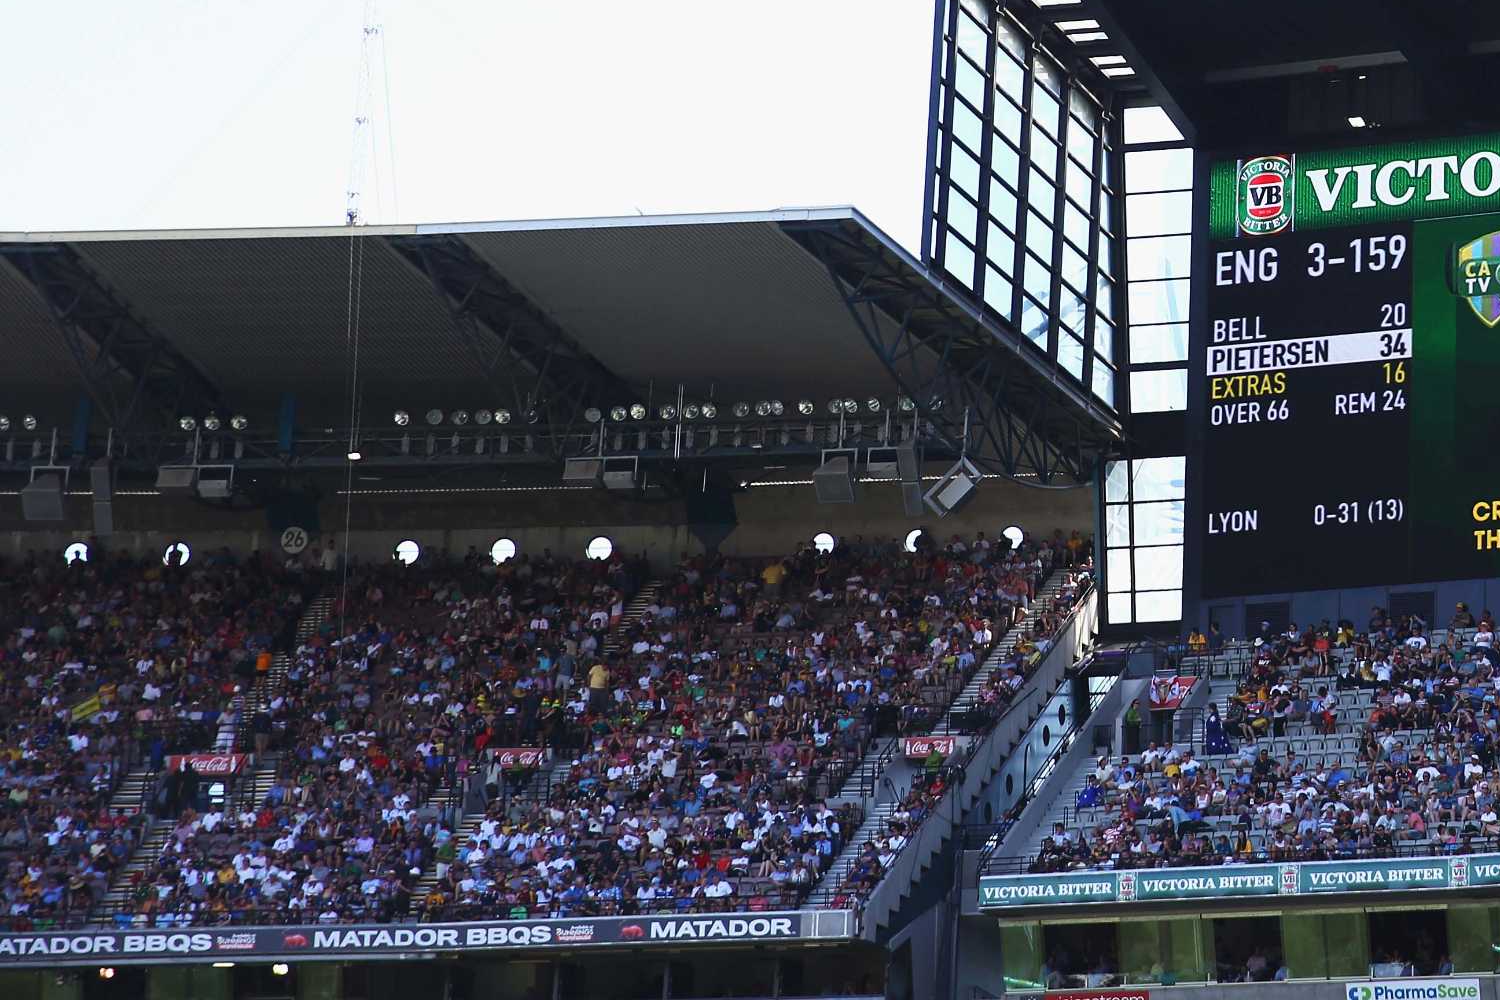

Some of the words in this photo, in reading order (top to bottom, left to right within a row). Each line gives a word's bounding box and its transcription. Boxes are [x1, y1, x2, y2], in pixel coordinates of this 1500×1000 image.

[1240, 161, 1290, 181] VICTORIA
[1249, 185, 1282, 206] VB
[1243, 214, 1288, 230] BITTER
[1215, 248, 1278, 286] ENG
[1307, 234, 1407, 277] 3-159
[1465, 262, 1490, 277] CA
[1465, 278, 1490, 294] TV
[1213, 317, 1267, 342] BELL
[1381, 303, 1406, 328] 20
[1212, 340, 1329, 372] PIETERSEN
[1379, 333, 1407, 358] 34
[1211, 372, 1286, 399] EXTRAS
[1383, 363, 1405, 384] 16
[1211, 401, 1260, 426] OVER
[1267, 400, 1289, 421] 66
[1335, 393, 1375, 415] REM
[1382, 390, 1406, 412] 24
[1208, 510, 1257, 534] LYON
[1314, 502, 1358, 526] 0-31
[1368, 498, 1404, 523] (13)
[284, 530, 304, 547] 26
[1143, 877, 1216, 892] VICTORIA
[1219, 875, 1274, 888] BITTER
[1310, 870, 1384, 885] VICTORIA
[1388, 868, 1443, 882] BITTER
[984, 884, 1055, 899] VICTORIA
[1059, 882, 1112, 896] BITTER
[313, 928, 459, 948] MATADOR
[466, 925, 551, 945] BBQS
[650, 918, 792, 939] MATADOR
[123, 934, 212, 953] BBQS
[1374, 984, 1478, 1000] PharmaSave
